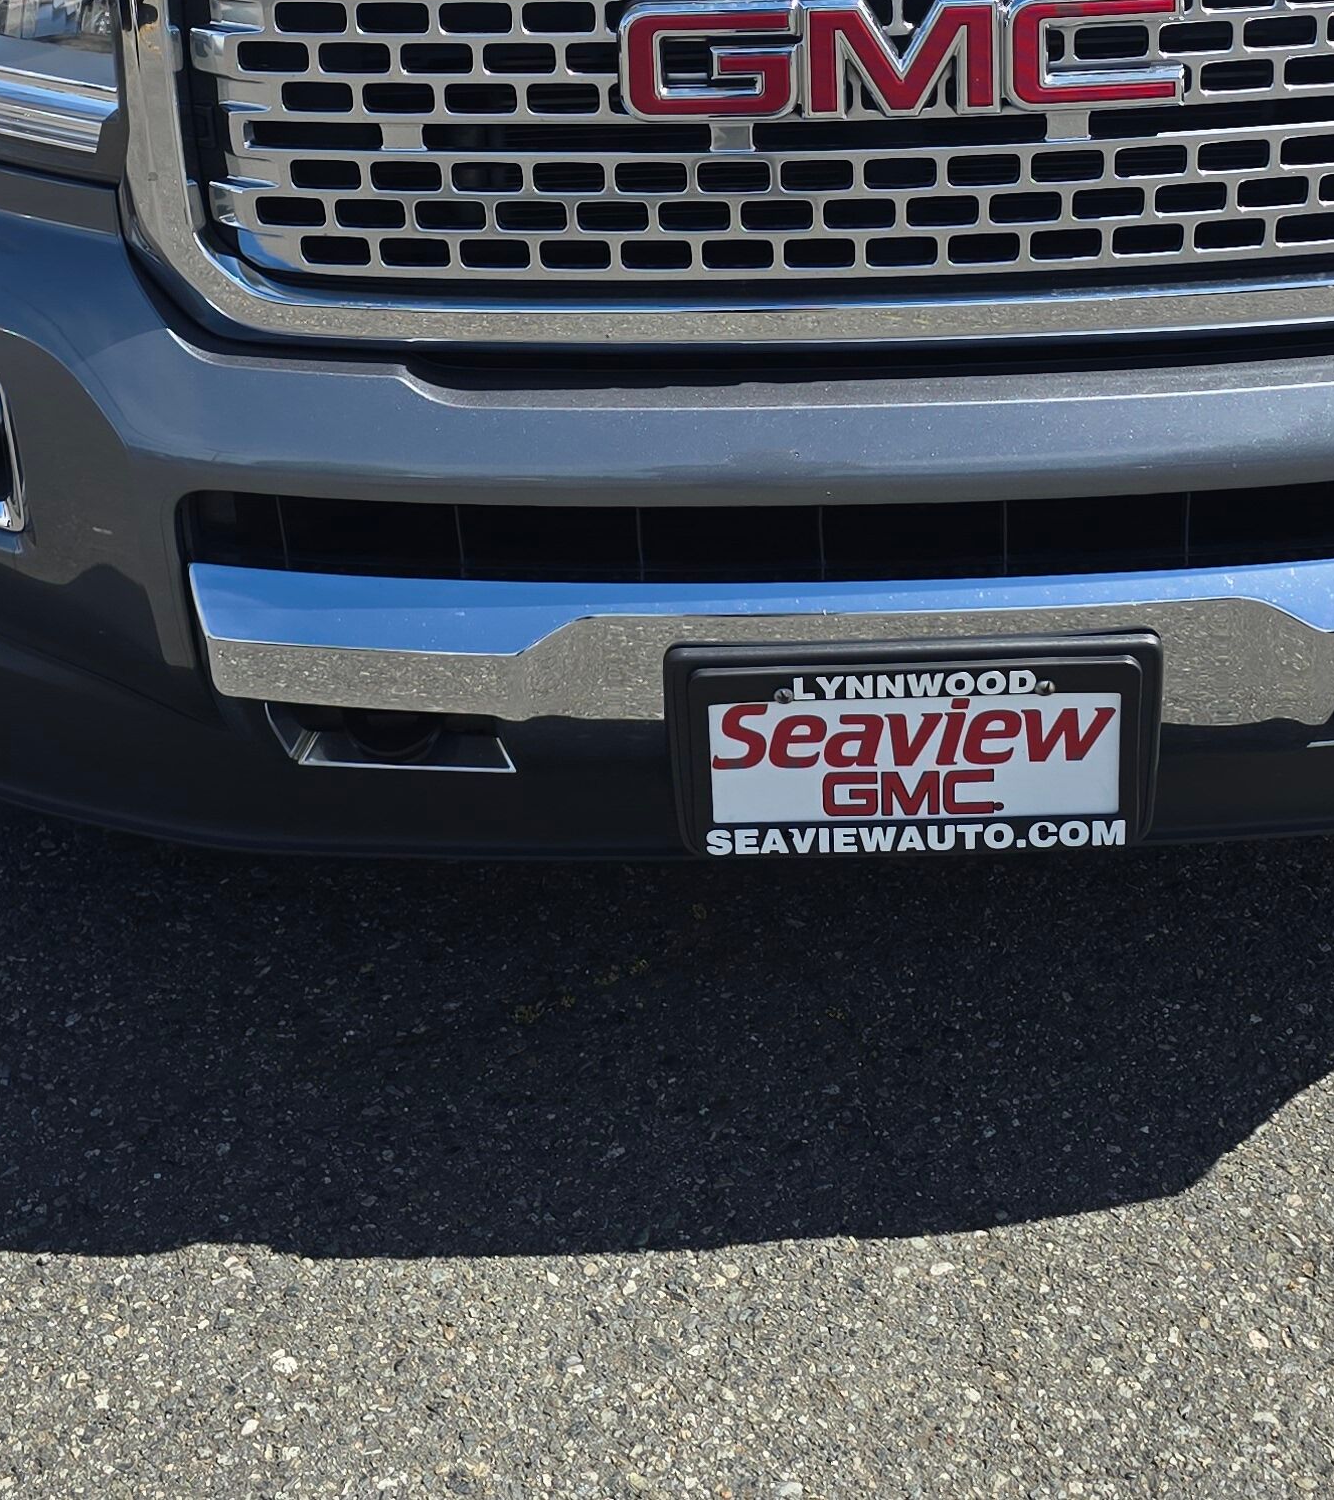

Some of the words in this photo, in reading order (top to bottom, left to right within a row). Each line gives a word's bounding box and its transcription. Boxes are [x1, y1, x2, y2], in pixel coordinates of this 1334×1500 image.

[793, 670, 1036, 701] LYNNWOOD
[712, 698, 1116, 770] Seaview
[706, 819, 1126, 856] SEAVIEWAUTO.COM
